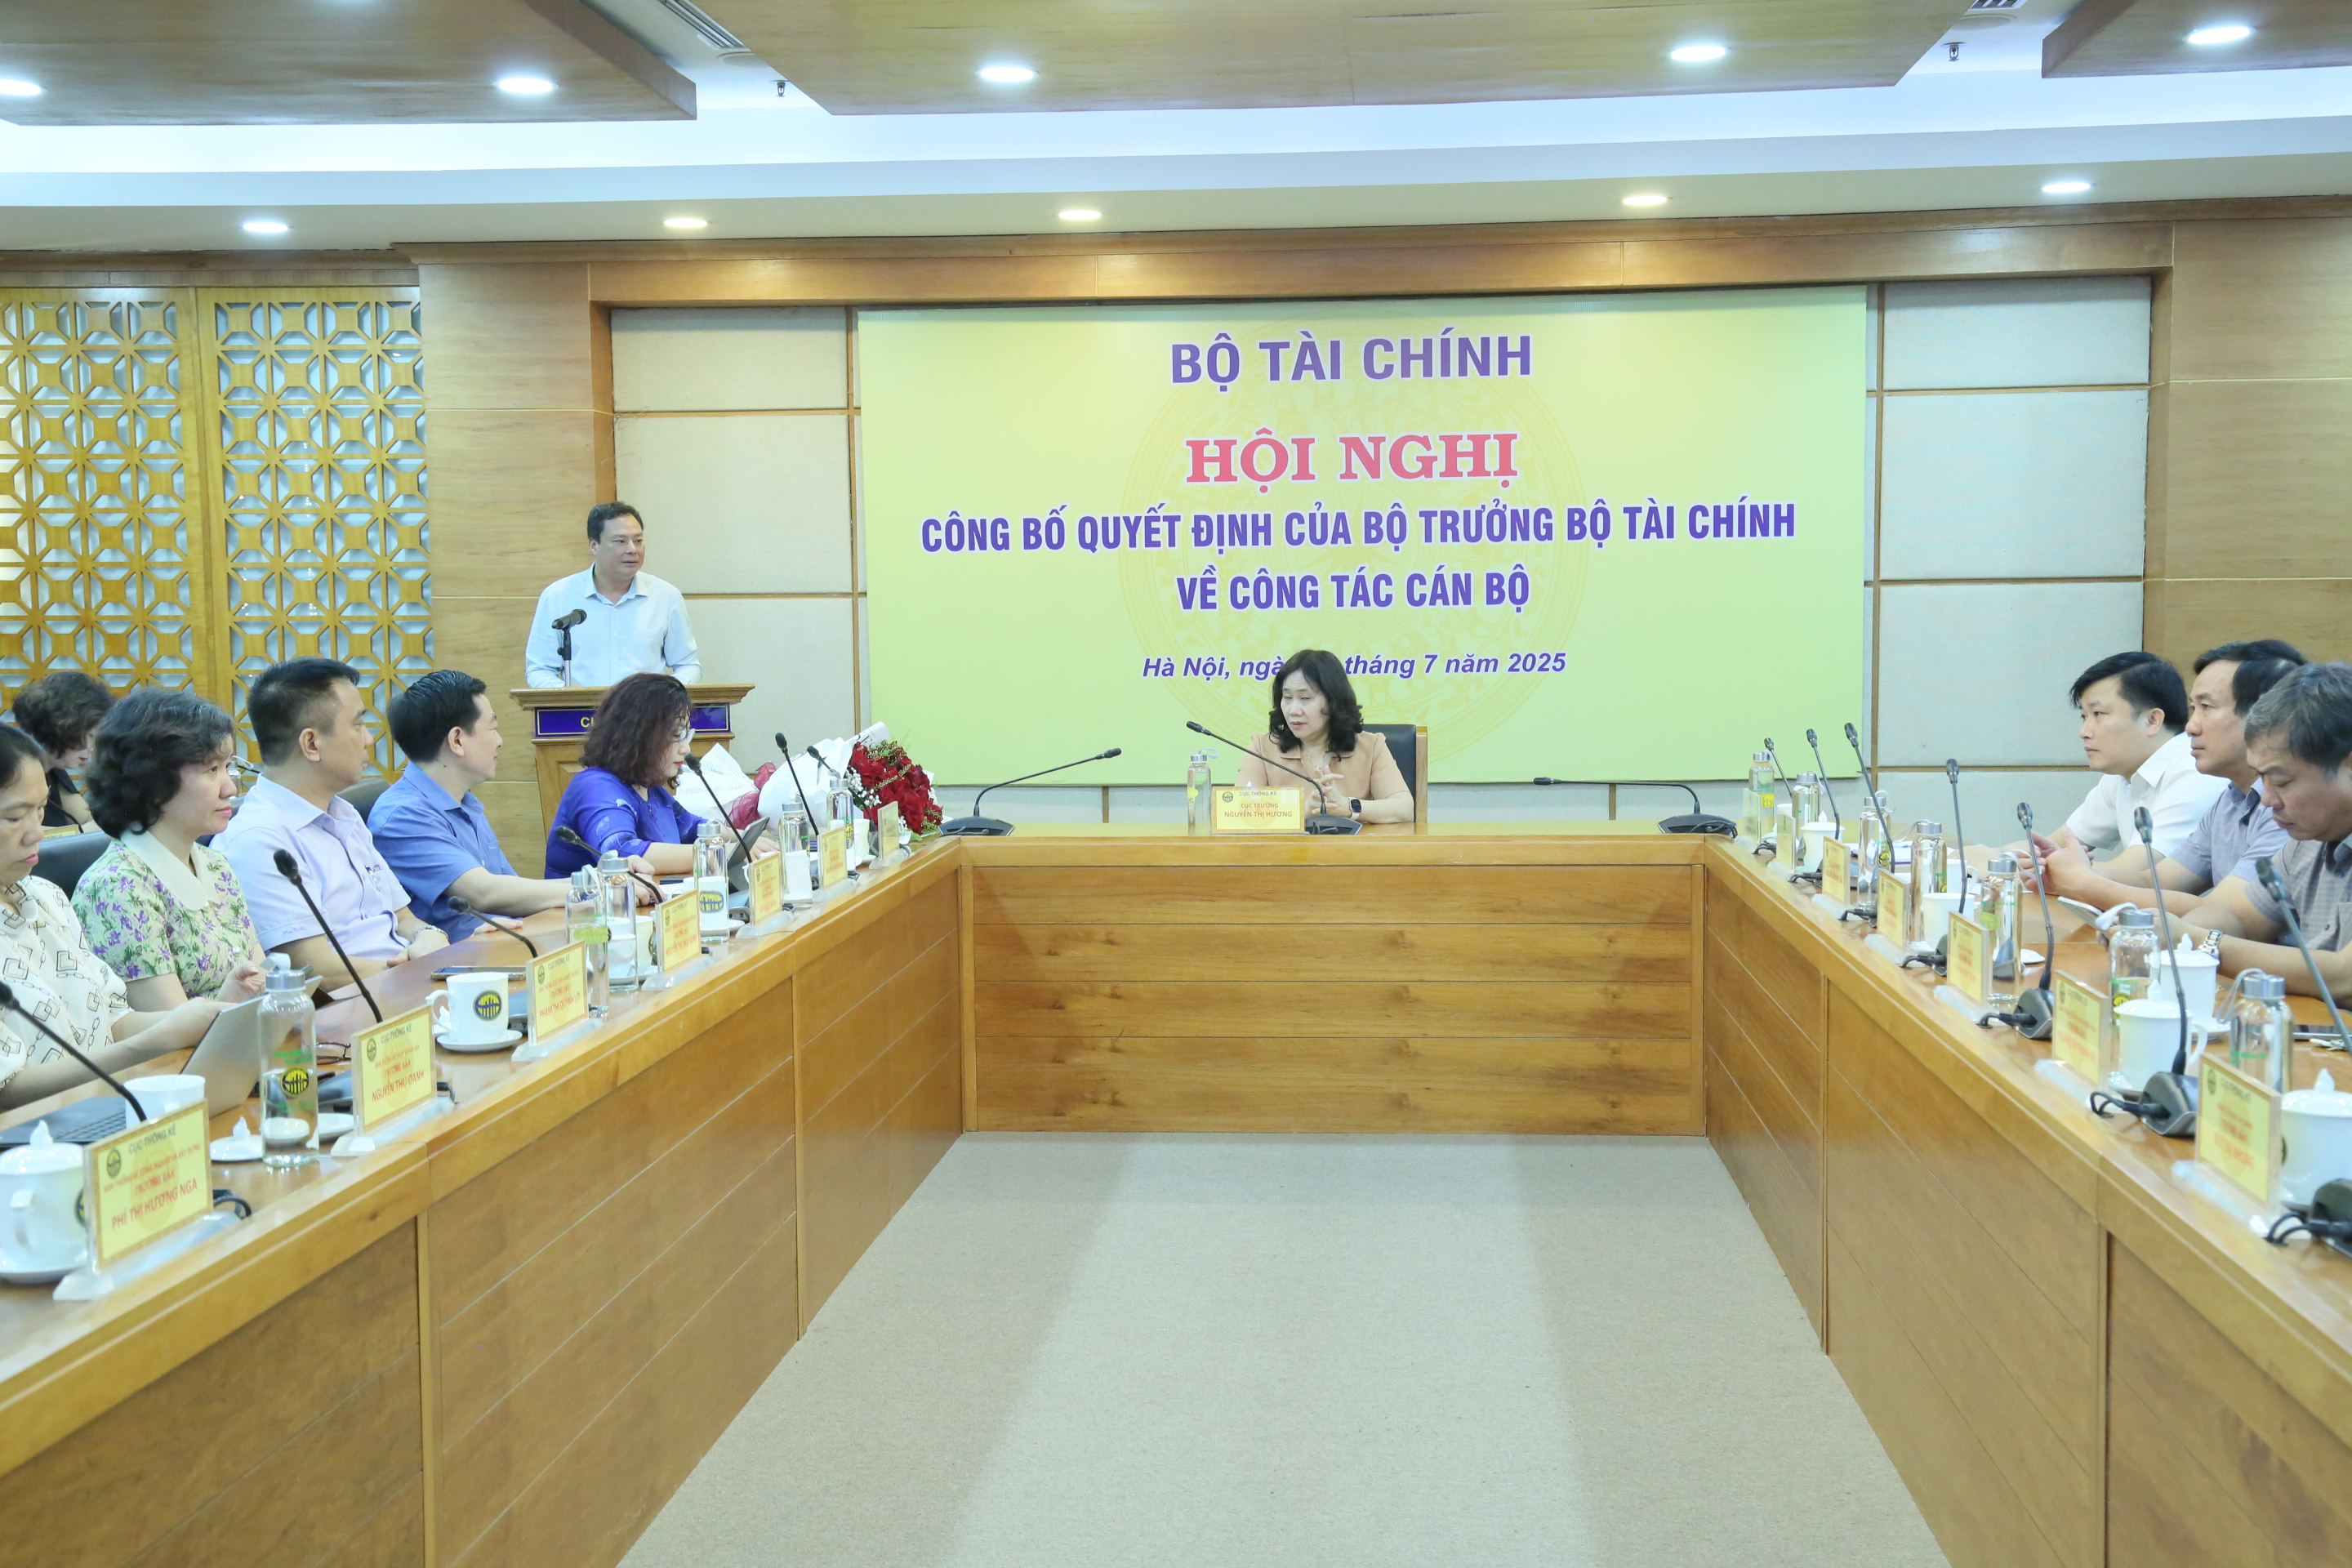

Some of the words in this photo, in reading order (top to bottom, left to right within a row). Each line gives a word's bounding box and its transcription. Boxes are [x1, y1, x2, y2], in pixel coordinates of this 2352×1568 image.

[1172, 333, 1240, 392] BỘ
[1258, 330, 1341, 381] TÀI
[1363, 327, 1530, 380] CHÍNH
[1187, 427, 1316, 493] HỘI
[1340, 433, 1517, 488] NGHỊ
[921, 510, 1009, 552] CÔNG
[1022, 504, 1067, 550] BỐ
[1077, 502, 1181, 554] QUYẾT
[1191, 514, 1272, 555] ĐỊNH
[1285, 501, 1352, 546] CỦA
[1364, 502, 1407, 552] BỘ
[1419, 498, 1553, 544] TRƯỞNG
[1566, 499, 1611, 549] BỘ
[1624, 497, 1675, 540] TÀI
[1688, 496, 1795, 539] CHÍNH
[1177, 564, 1218, 610] VỀ
[1229, 568, 1319, 610] CÔNG
[1330, 567, 1393, 608] TÁC
[1405, 565, 1472, 608] CÁN
[1486, 564, 1530, 613] BỘ
[1143, 656, 1175, 678] Hà
[1183, 657, 1231, 681] Nội,
[1240, 656, 1285, 681] ngà
[1344, 654, 1415, 679] tháng
[1425, 655, 1439, 674] 7
[1445, 653, 1499, 674] năm
[1508, 653, 1566, 673] 2025
[1224, 809, 1252, 817] NGUYỄN
[395, 1075, 407, 1091] THU
[408, 1068, 424, 1085] OANH
[180, 1178, 198, 1197] NGA
